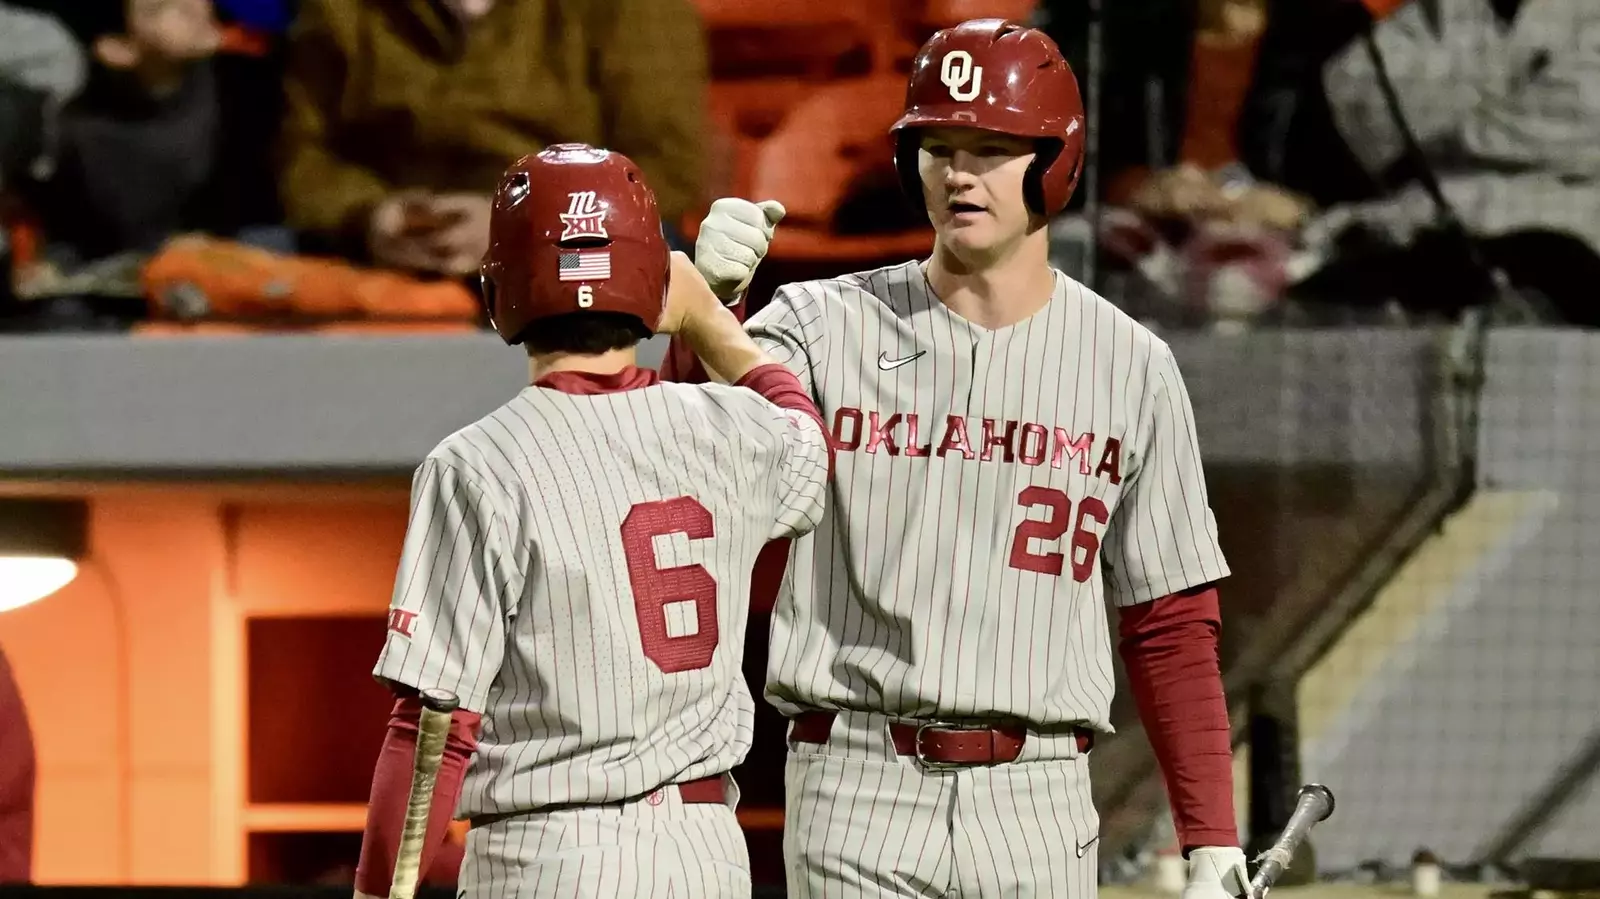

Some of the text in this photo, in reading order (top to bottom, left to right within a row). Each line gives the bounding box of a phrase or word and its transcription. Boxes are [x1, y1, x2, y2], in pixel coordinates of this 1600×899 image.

[941, 50, 983, 102] OU
[578, 285, 594, 308] 6
[832, 406, 1121, 485] OKLAHOMA
[1008, 485, 1109, 583] 26
[620, 495, 719, 674] 6
